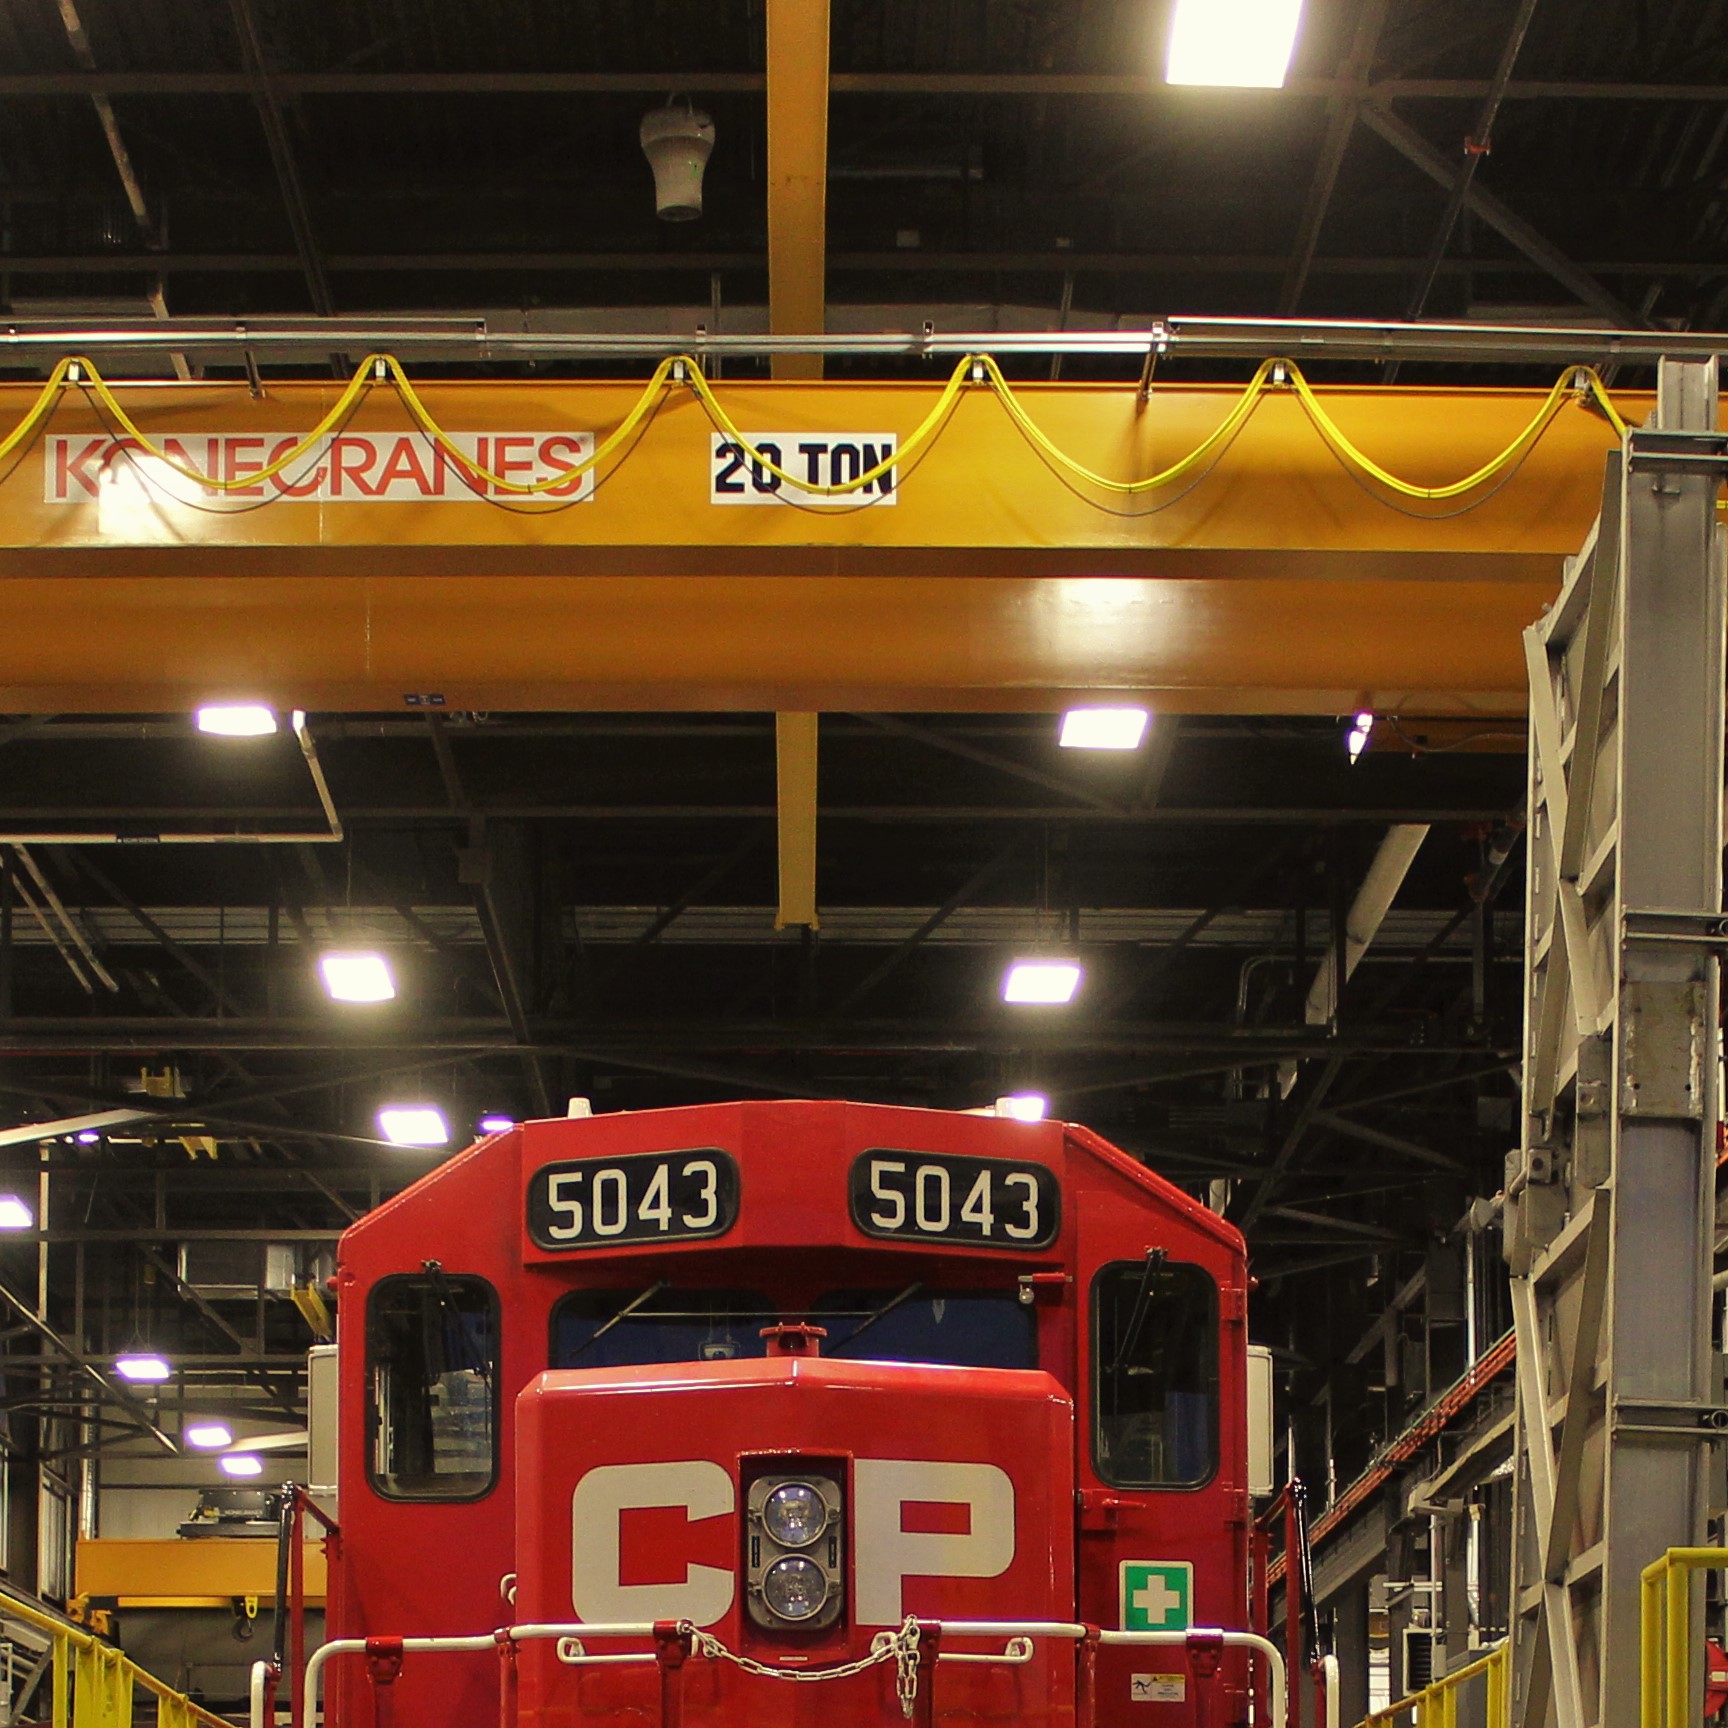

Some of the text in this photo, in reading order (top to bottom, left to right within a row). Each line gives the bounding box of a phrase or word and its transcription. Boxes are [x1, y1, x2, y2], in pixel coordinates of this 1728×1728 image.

[715, 442, 893, 494] 20 TON
[547, 1160, 719, 1240] 5043
[871, 1160, 1040, 1240] 5043
[573, 1459, 1015, 1626] CP
